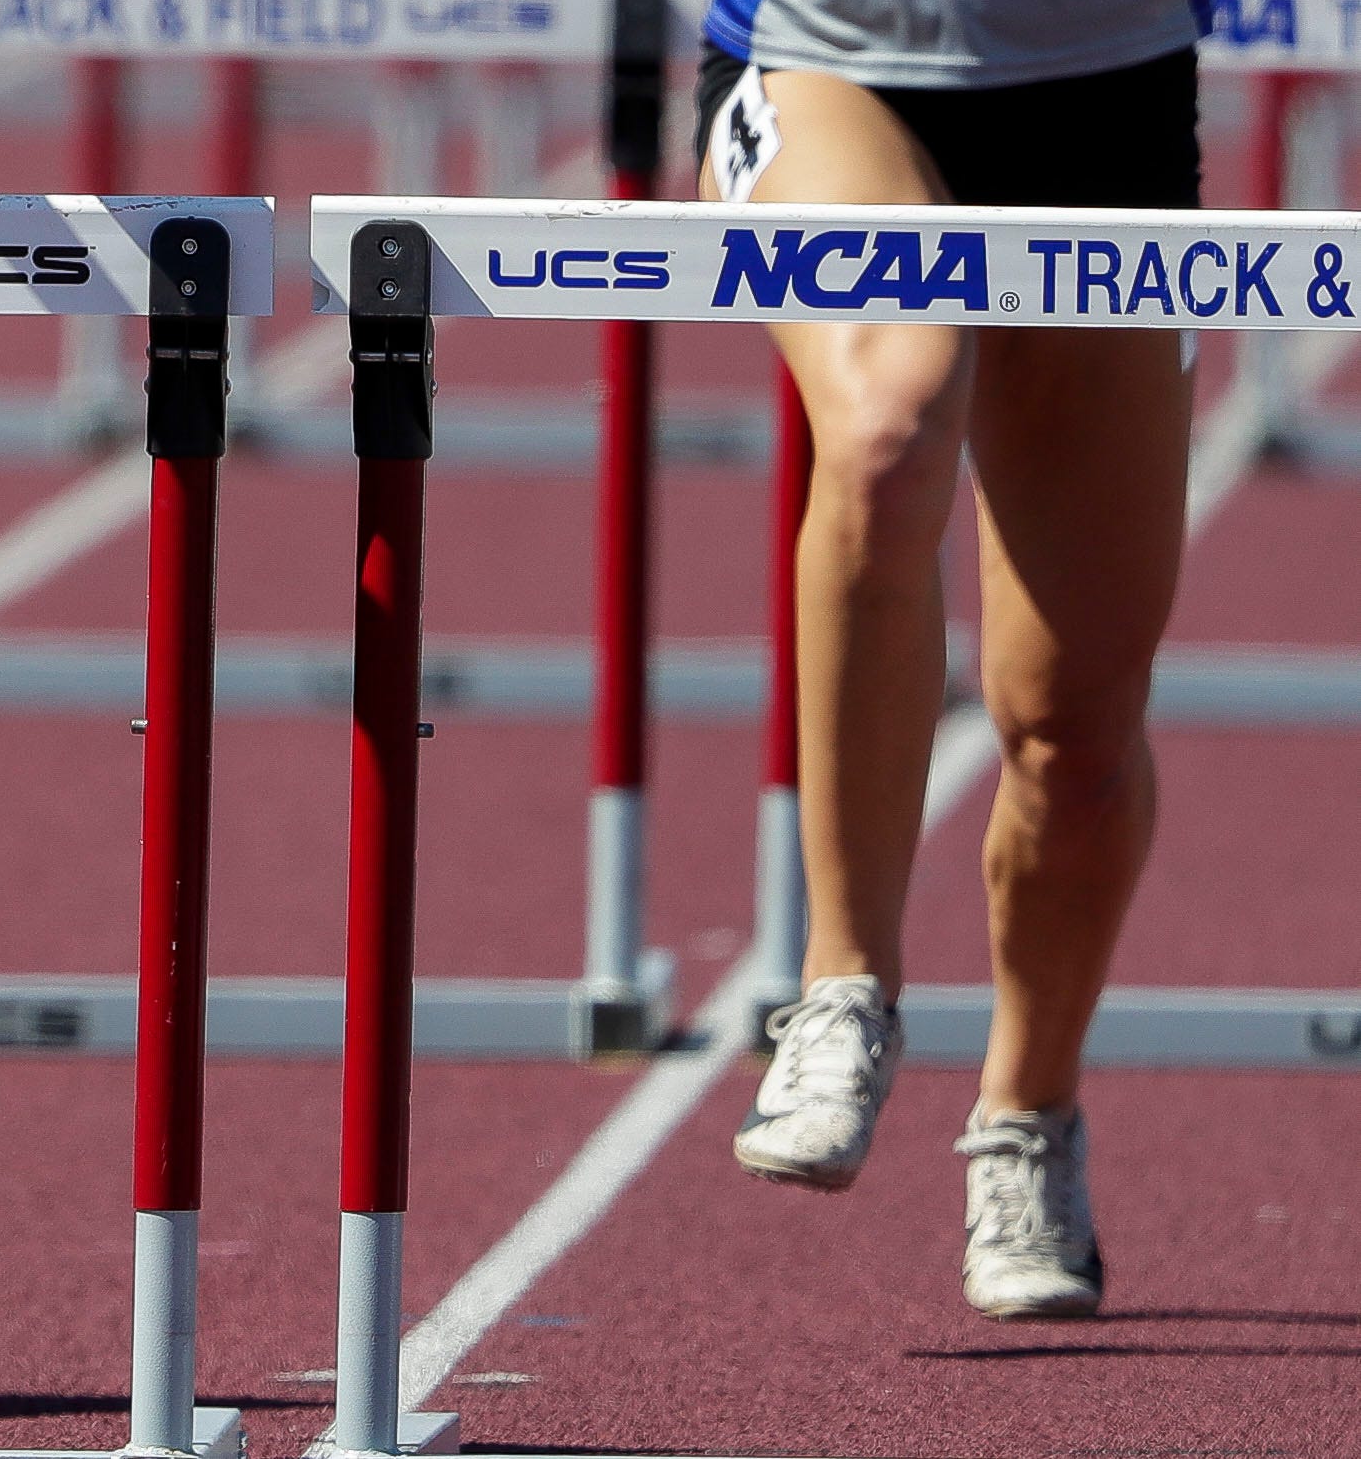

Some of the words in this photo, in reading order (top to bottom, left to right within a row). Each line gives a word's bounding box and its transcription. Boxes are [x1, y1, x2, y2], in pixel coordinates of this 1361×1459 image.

[489, 250, 671, 289] UCS
[711, 228, 989, 310] NCAA
[1028, 239, 1285, 317] TRACK
[1307, 242, 1356, 318] &
